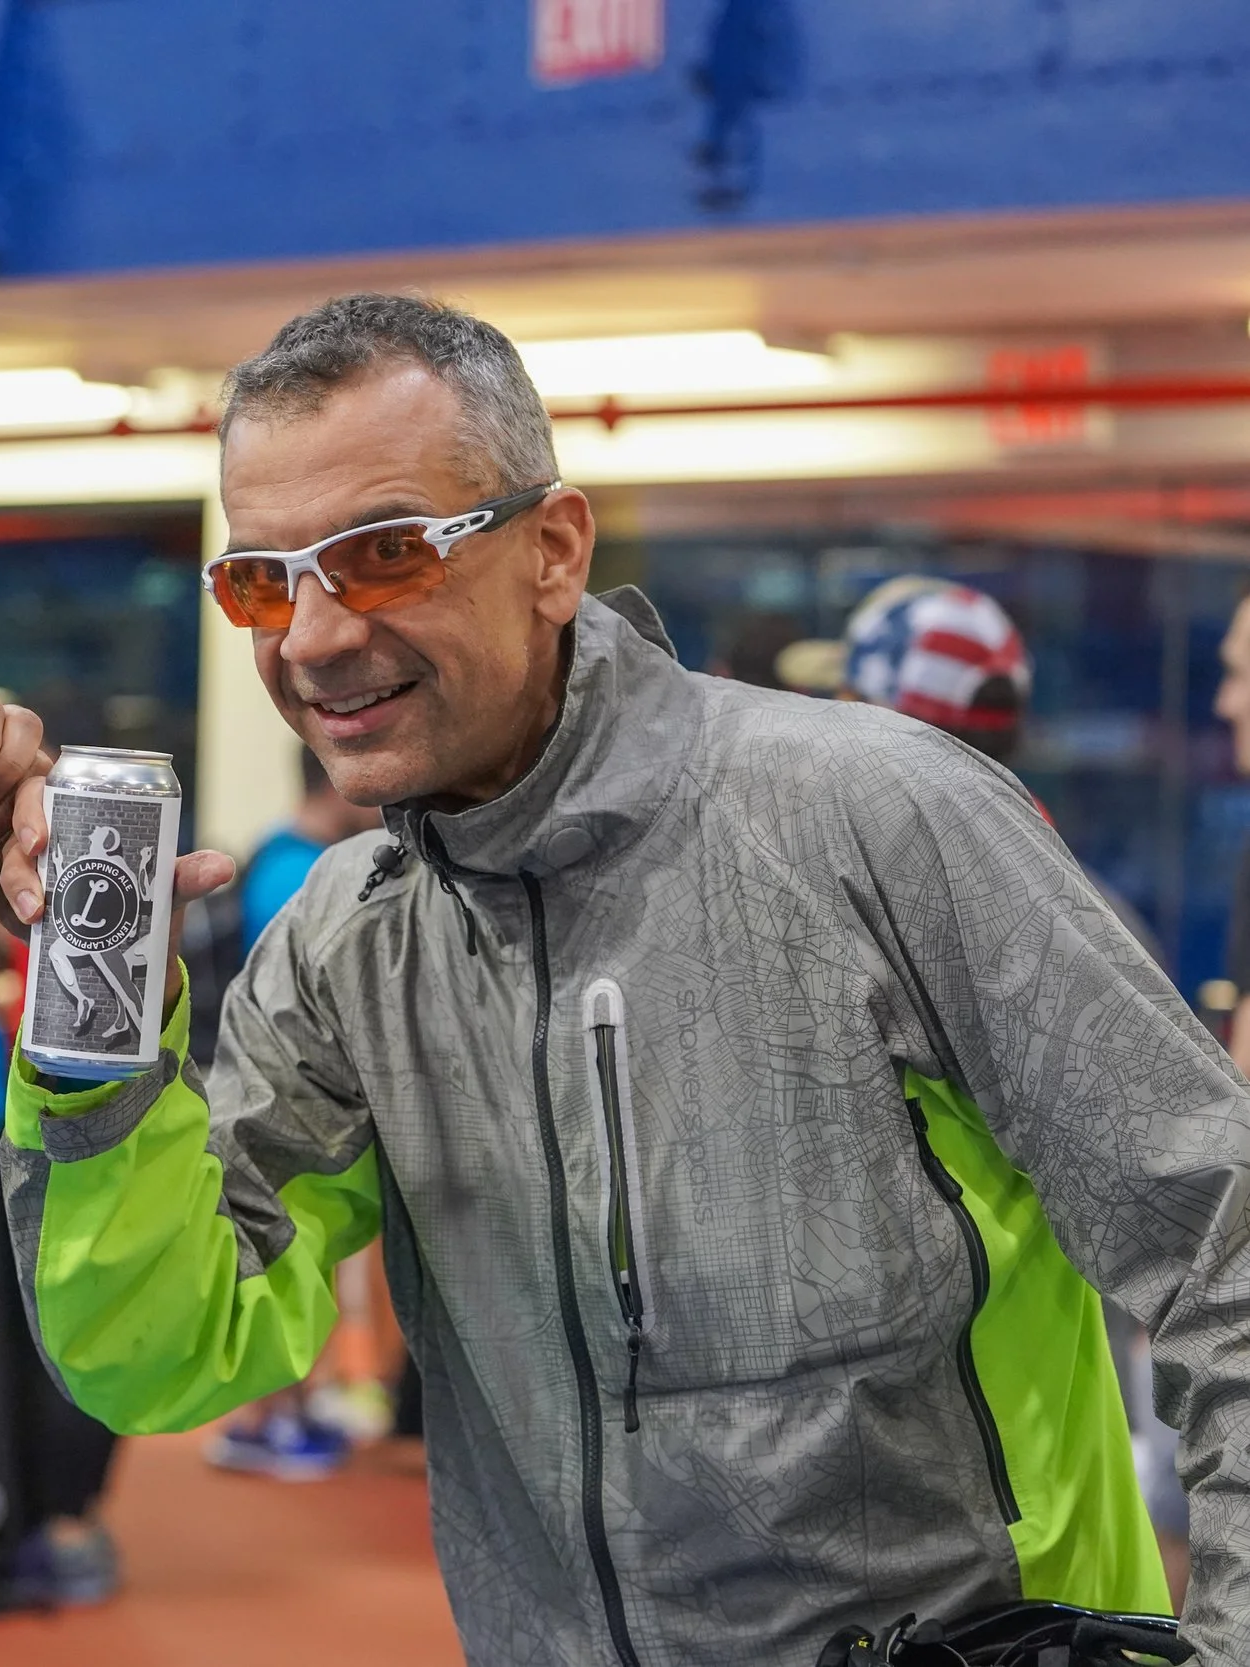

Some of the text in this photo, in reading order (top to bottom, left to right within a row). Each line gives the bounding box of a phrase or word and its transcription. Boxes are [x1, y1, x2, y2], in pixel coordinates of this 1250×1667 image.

[57, 862, 133, 893] LENOX LAPPING ALE
[70, 880, 109, 928] L
[55, 917, 132, 950] LENOX LAPPING ALE
